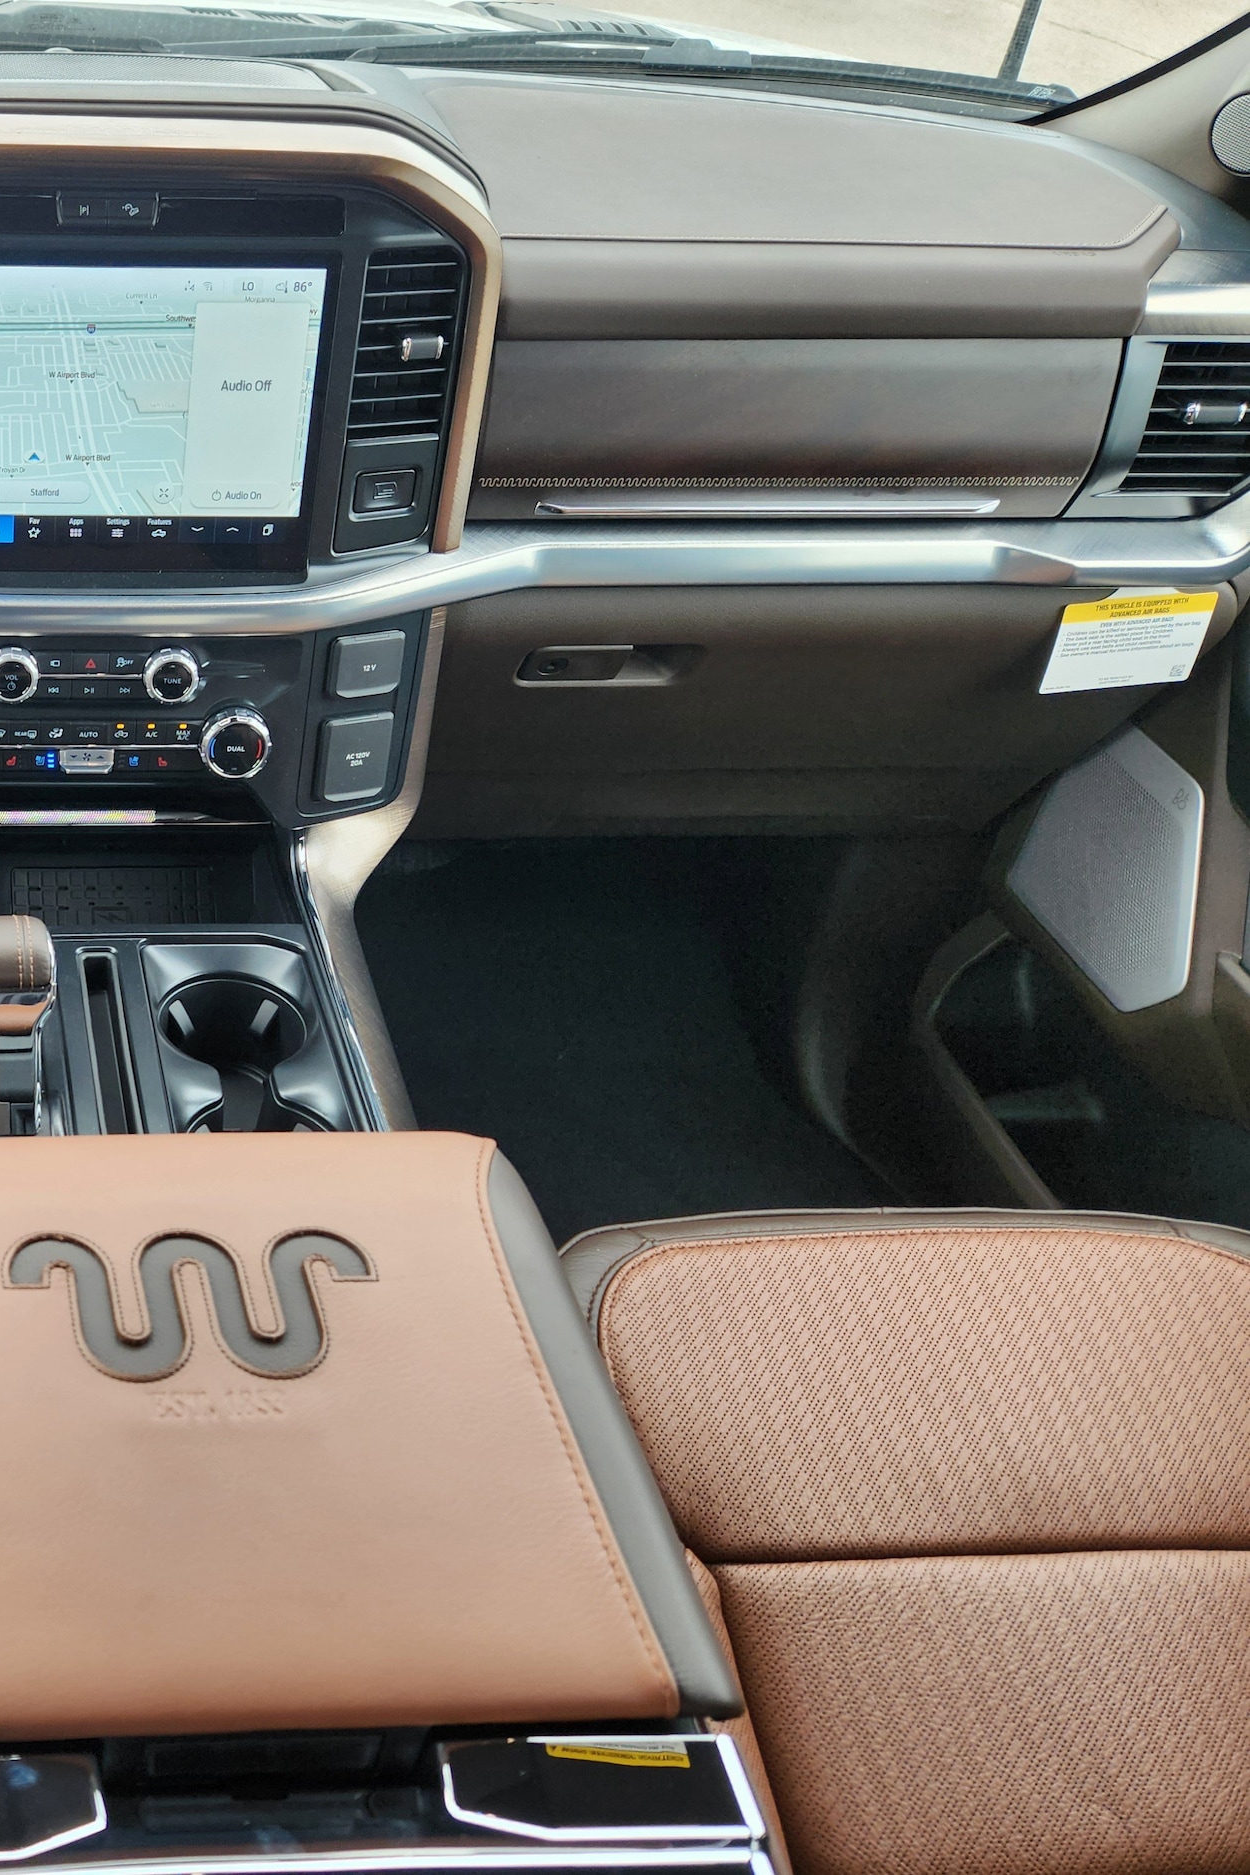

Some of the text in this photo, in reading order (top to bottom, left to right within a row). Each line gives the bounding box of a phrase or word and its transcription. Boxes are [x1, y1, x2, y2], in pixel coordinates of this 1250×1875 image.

[293, 281, 312, 292] 86°
[57, 371, 79, 380] Airport
[80, 370, 96, 378] Blvd
[220, 379, 272, 392] Audio Off
[73, 454, 95, 462] Airport
[30, 488, 60, 496] Stafford
[225, 491, 261, 500] Audio On
[69, 517, 83, 526] Apps
[106, 518, 130, 527] Settings
[147, 518, 172, 526] Features
[1096, 603, 1109, 611] THIS
[1110, 601, 1135, 609] VEHICLE
[1143, 598, 1172, 607] EQUIPPED
[1109, 609, 1141, 617] ADVANCED
